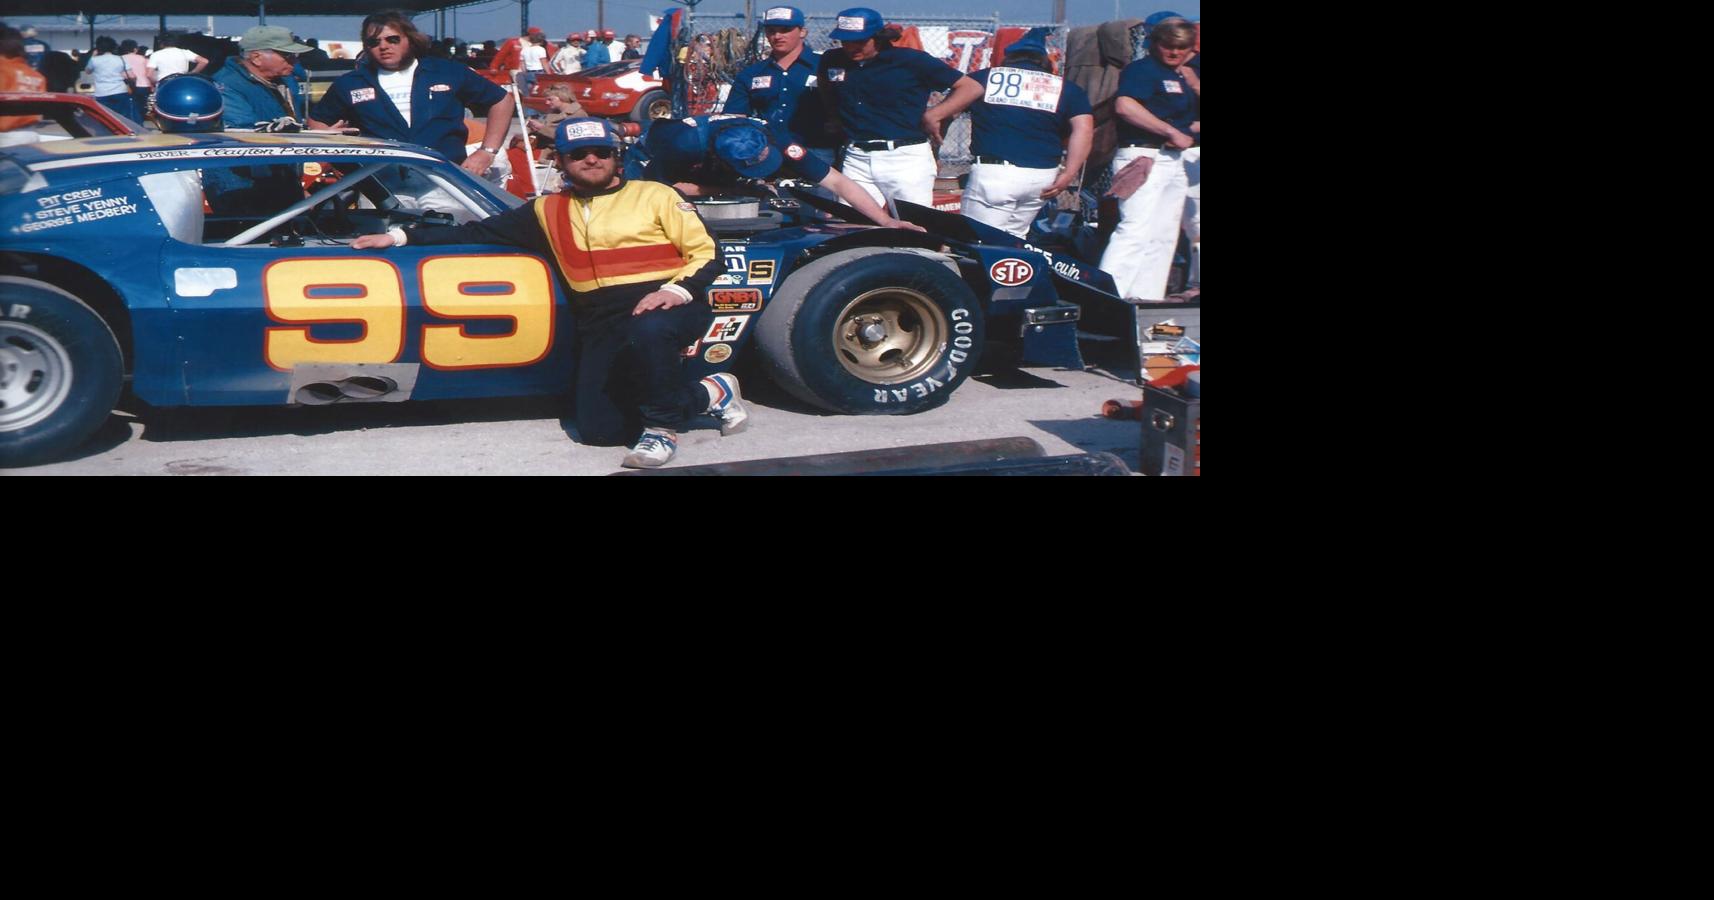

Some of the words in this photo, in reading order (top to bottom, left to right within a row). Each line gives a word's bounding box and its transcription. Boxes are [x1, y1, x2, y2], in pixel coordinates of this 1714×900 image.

[989, 71, 1022, 98] 98
[203, 147, 275, 158] Clayton
[279, 146, 362, 156] Petersen
[35, 203, 82, 219] STEVE
[82, 196, 128, 211] YENNY
[37, 194, 61, 207] PIT
[62, 187, 102, 202] CREW
[20, 215, 74, 233] GEORGE
[76, 203, 137, 223] MEDBERY
[994, 261, 1029, 283] STP
[261, 254, 556, 373] 99
